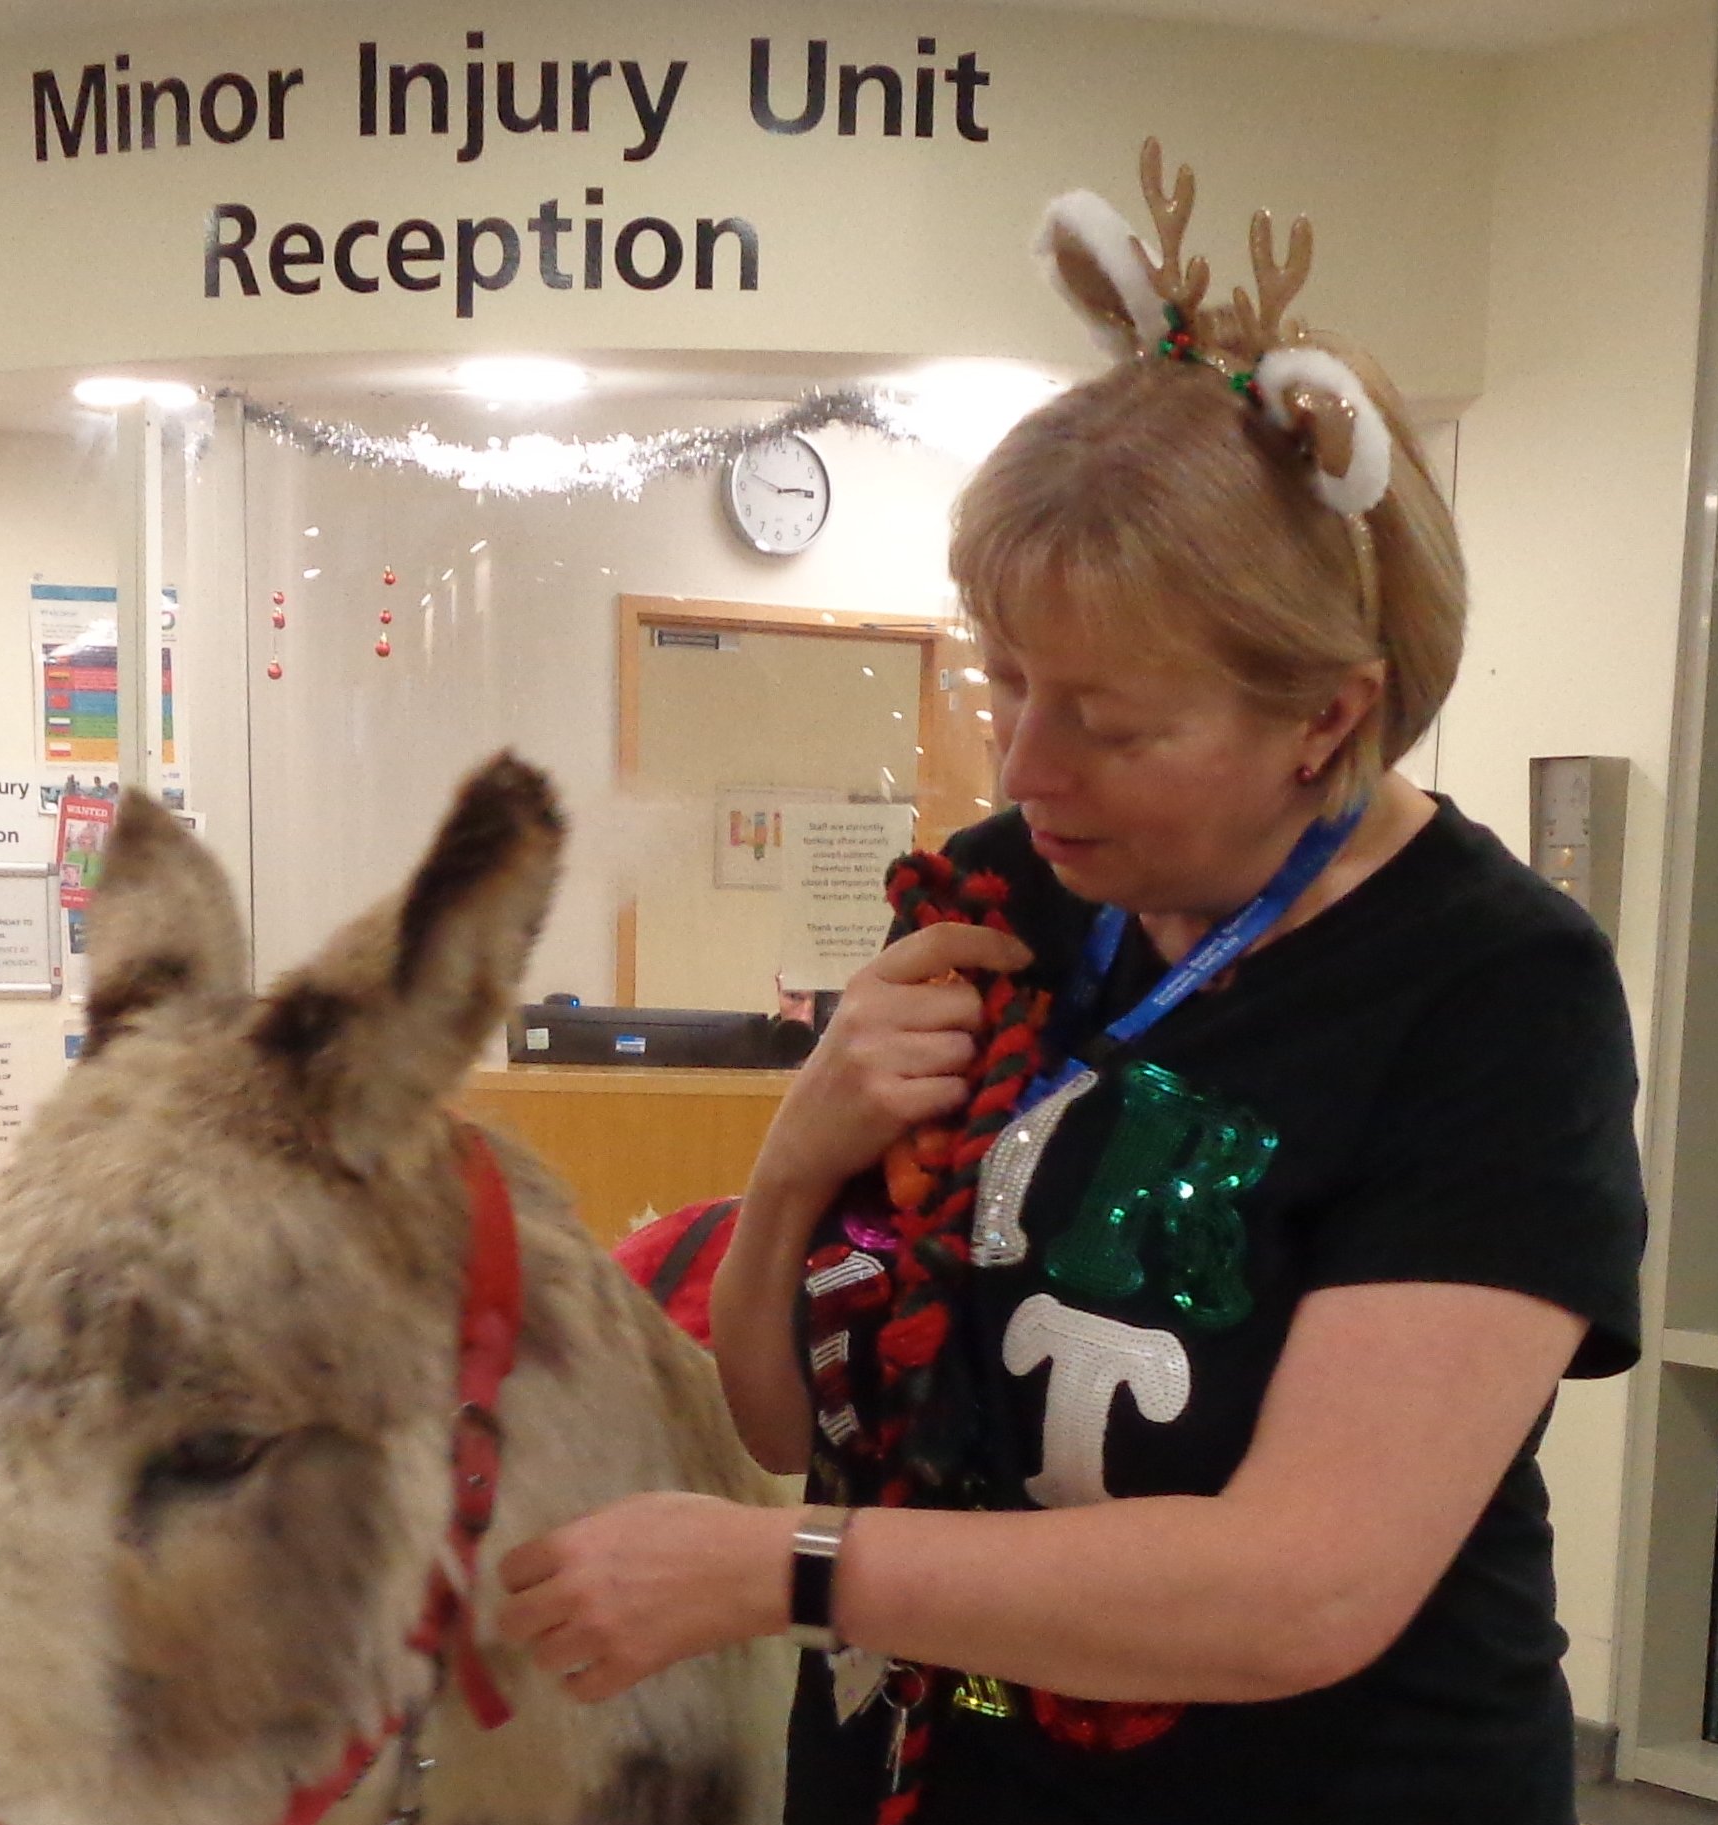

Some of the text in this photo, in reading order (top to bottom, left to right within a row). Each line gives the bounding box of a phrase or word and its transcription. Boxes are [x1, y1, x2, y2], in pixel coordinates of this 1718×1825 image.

[32, 31, 991, 162] Minor Injury Unit
[203, 187, 760, 319] Reception
